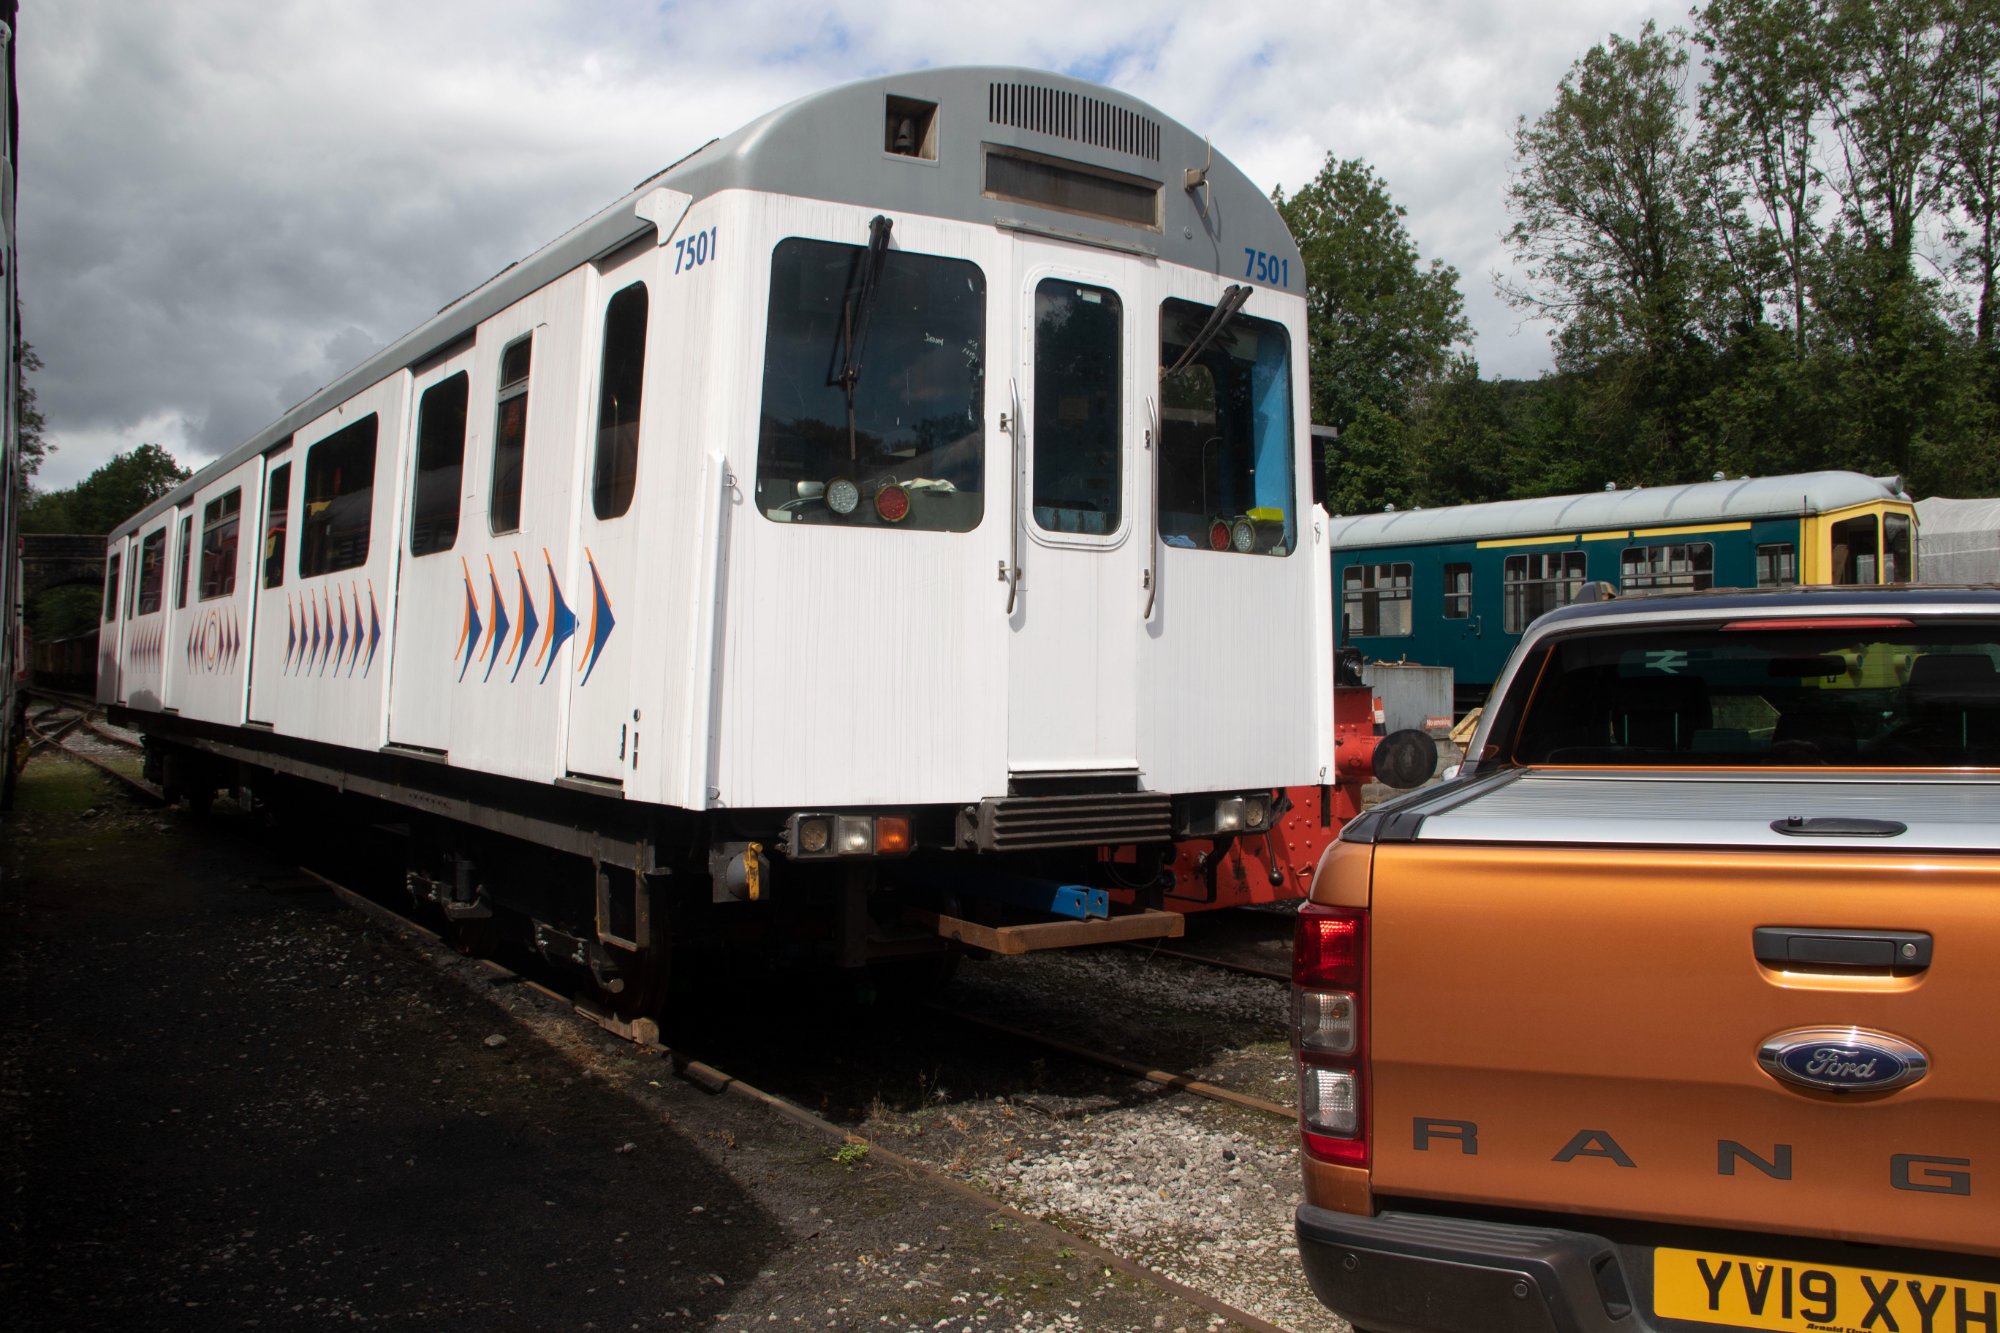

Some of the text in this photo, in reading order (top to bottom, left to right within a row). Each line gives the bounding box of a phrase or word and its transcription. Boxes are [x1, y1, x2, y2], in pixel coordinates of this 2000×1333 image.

[675, 226, 717, 275] 7501
[1245, 247, 1288, 288] 7501
[1806, 1048, 1877, 1078] Ford
[1696, 1258, 1997, 1333] YV19 XYH
